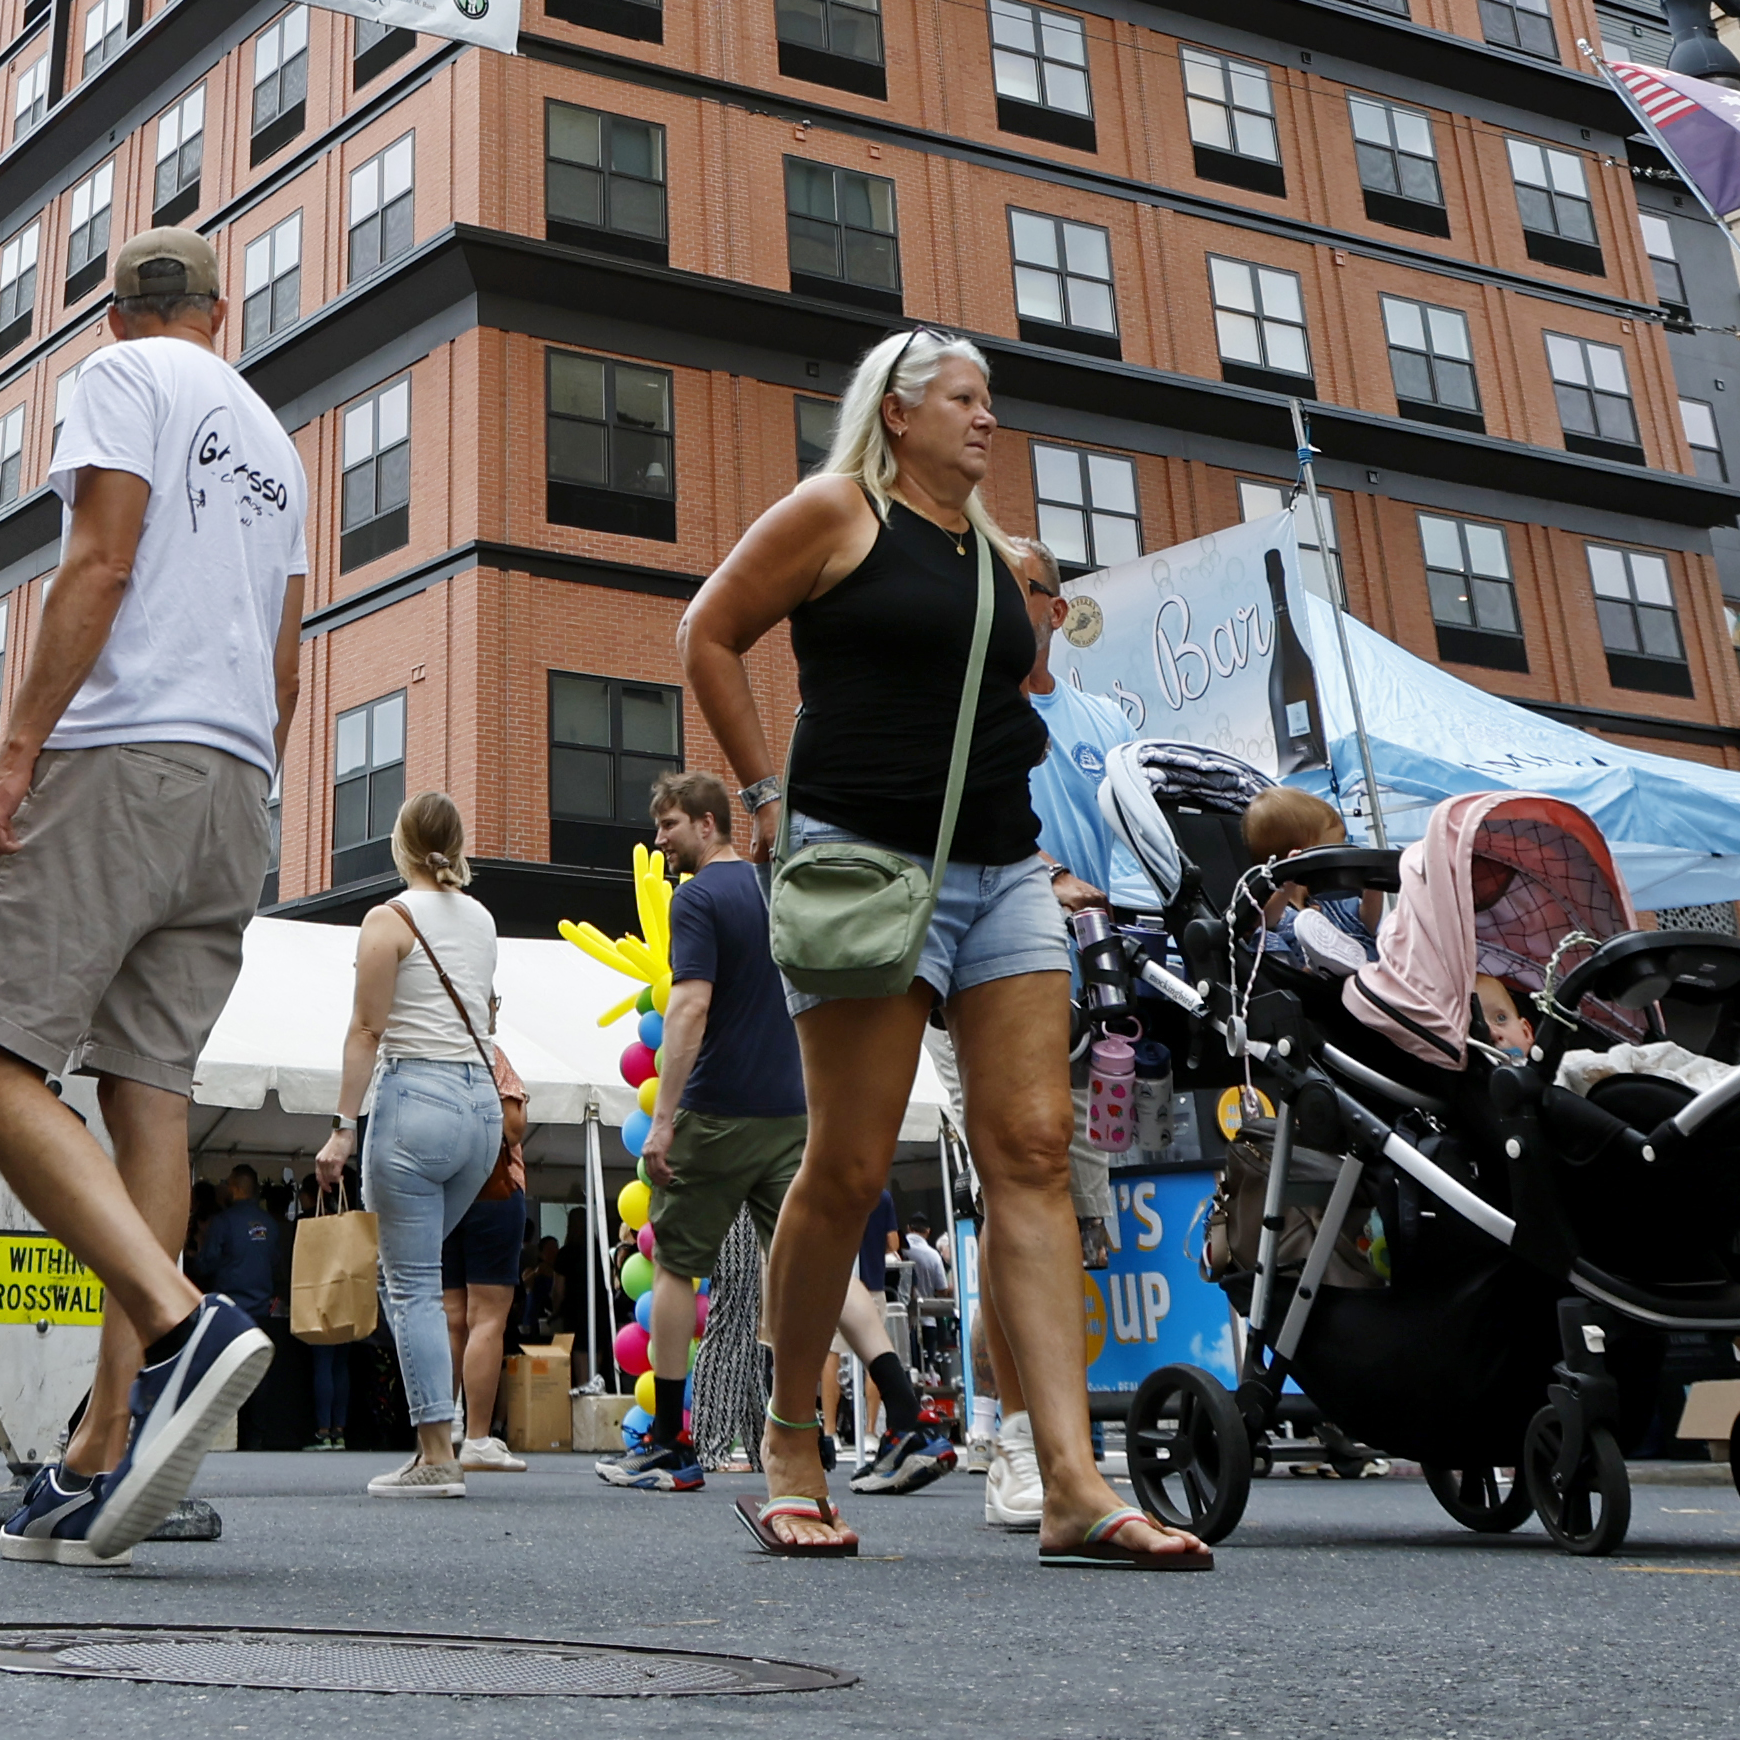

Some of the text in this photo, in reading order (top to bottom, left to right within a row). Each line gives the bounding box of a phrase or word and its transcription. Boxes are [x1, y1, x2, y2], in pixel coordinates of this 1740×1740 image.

[1152, 593, 1274, 711] Bar
[1148, 973, 1196, 1008] mockingbird
[1110, 1271, 1171, 1343] UP
